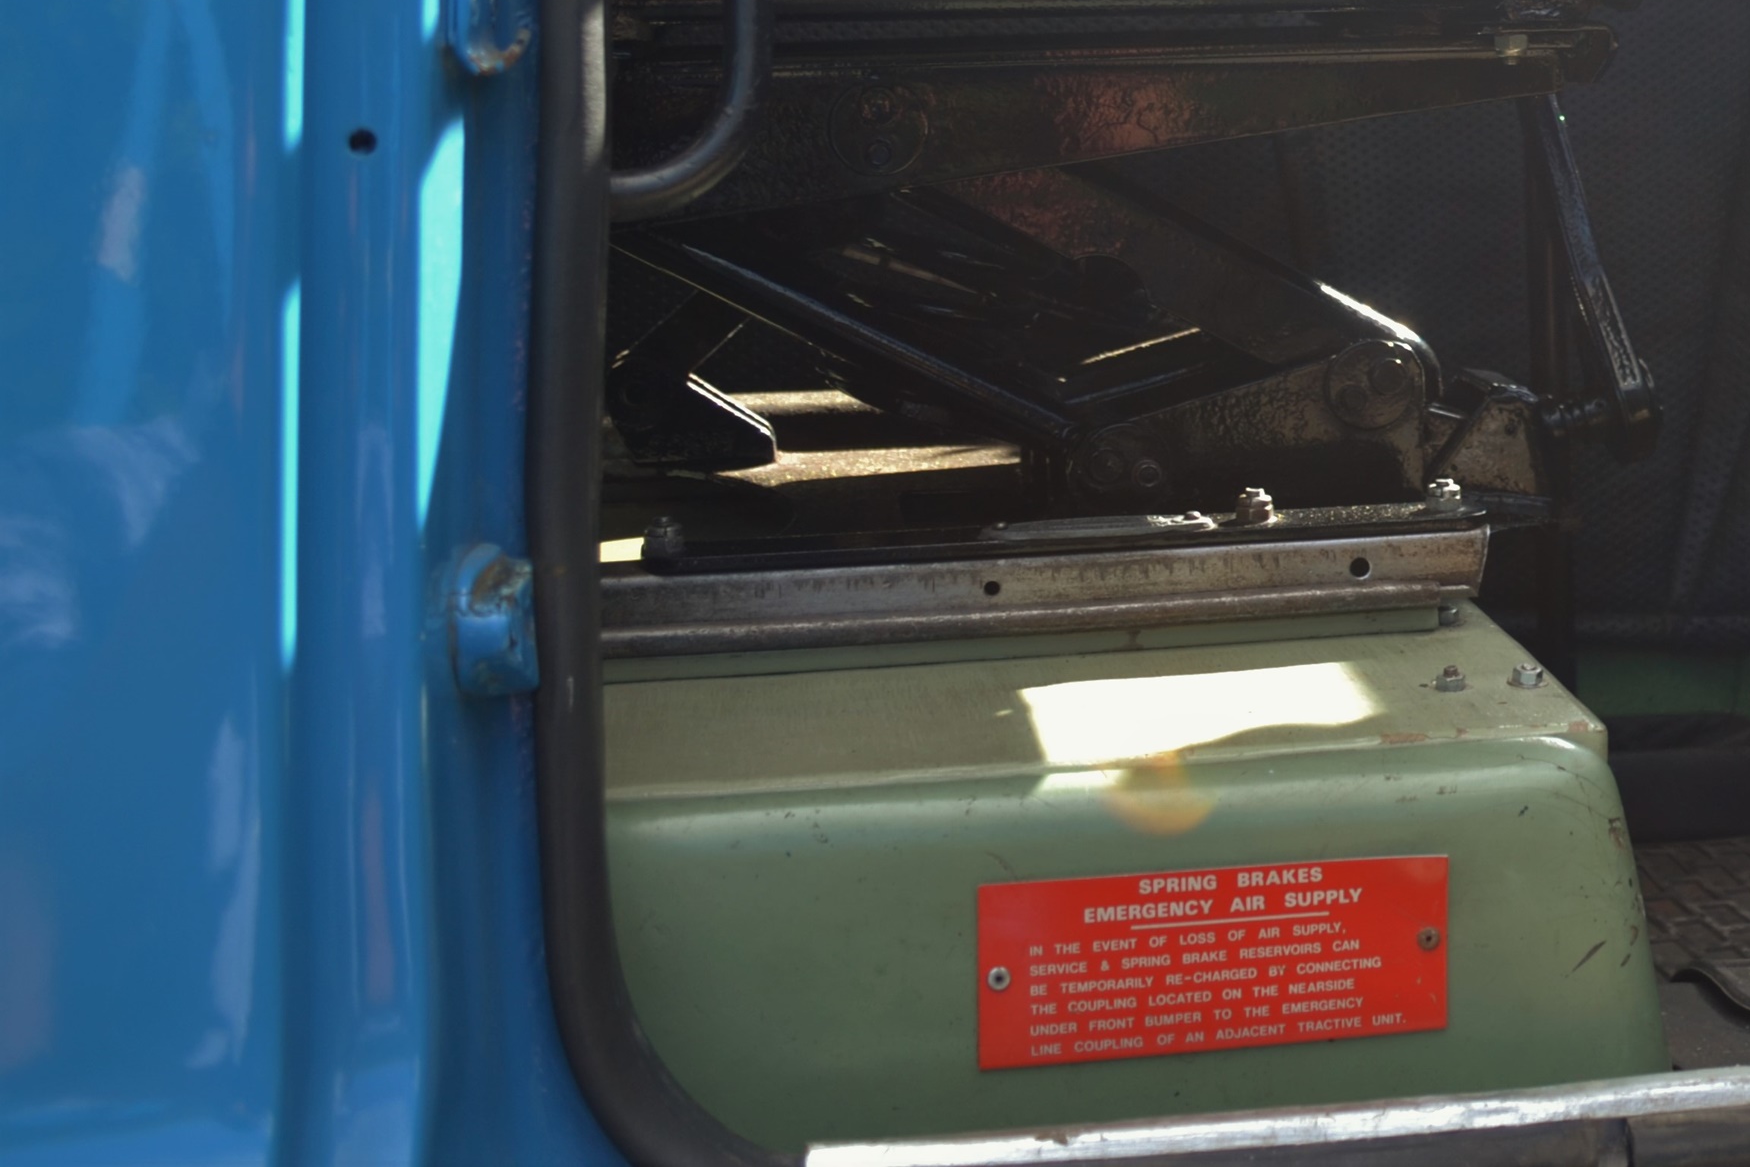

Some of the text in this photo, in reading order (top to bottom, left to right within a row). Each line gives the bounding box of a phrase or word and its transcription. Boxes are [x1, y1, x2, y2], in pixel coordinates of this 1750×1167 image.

[1138, 867, 1323, 895] SPRING BRAKES
[1083, 886, 1363, 925] EMERGENCY AIR SUPPLY
[1029, 921, 1346, 957] IN THE EVENT OF LOSS OF AIR SUPPLY,
[1029, 938, 1361, 977] SERVICE & SPRING BRAKE RESERVOIRS CAN
[1029, 955, 1383, 997] BE TEMPORARILY RE-CHARGED BY CONNECTING
[1030, 977, 1355, 1016] THE COUPLING LOCATED ON THE NEARSIDE
[1029, 996, 1364, 1037] UNDER FRONT BUMPER TO THE EMERGENCY
[1030, 1012, 1406, 1057] LINE COUPLING OF AN ADJACENT TRACTIVE UNIT.
